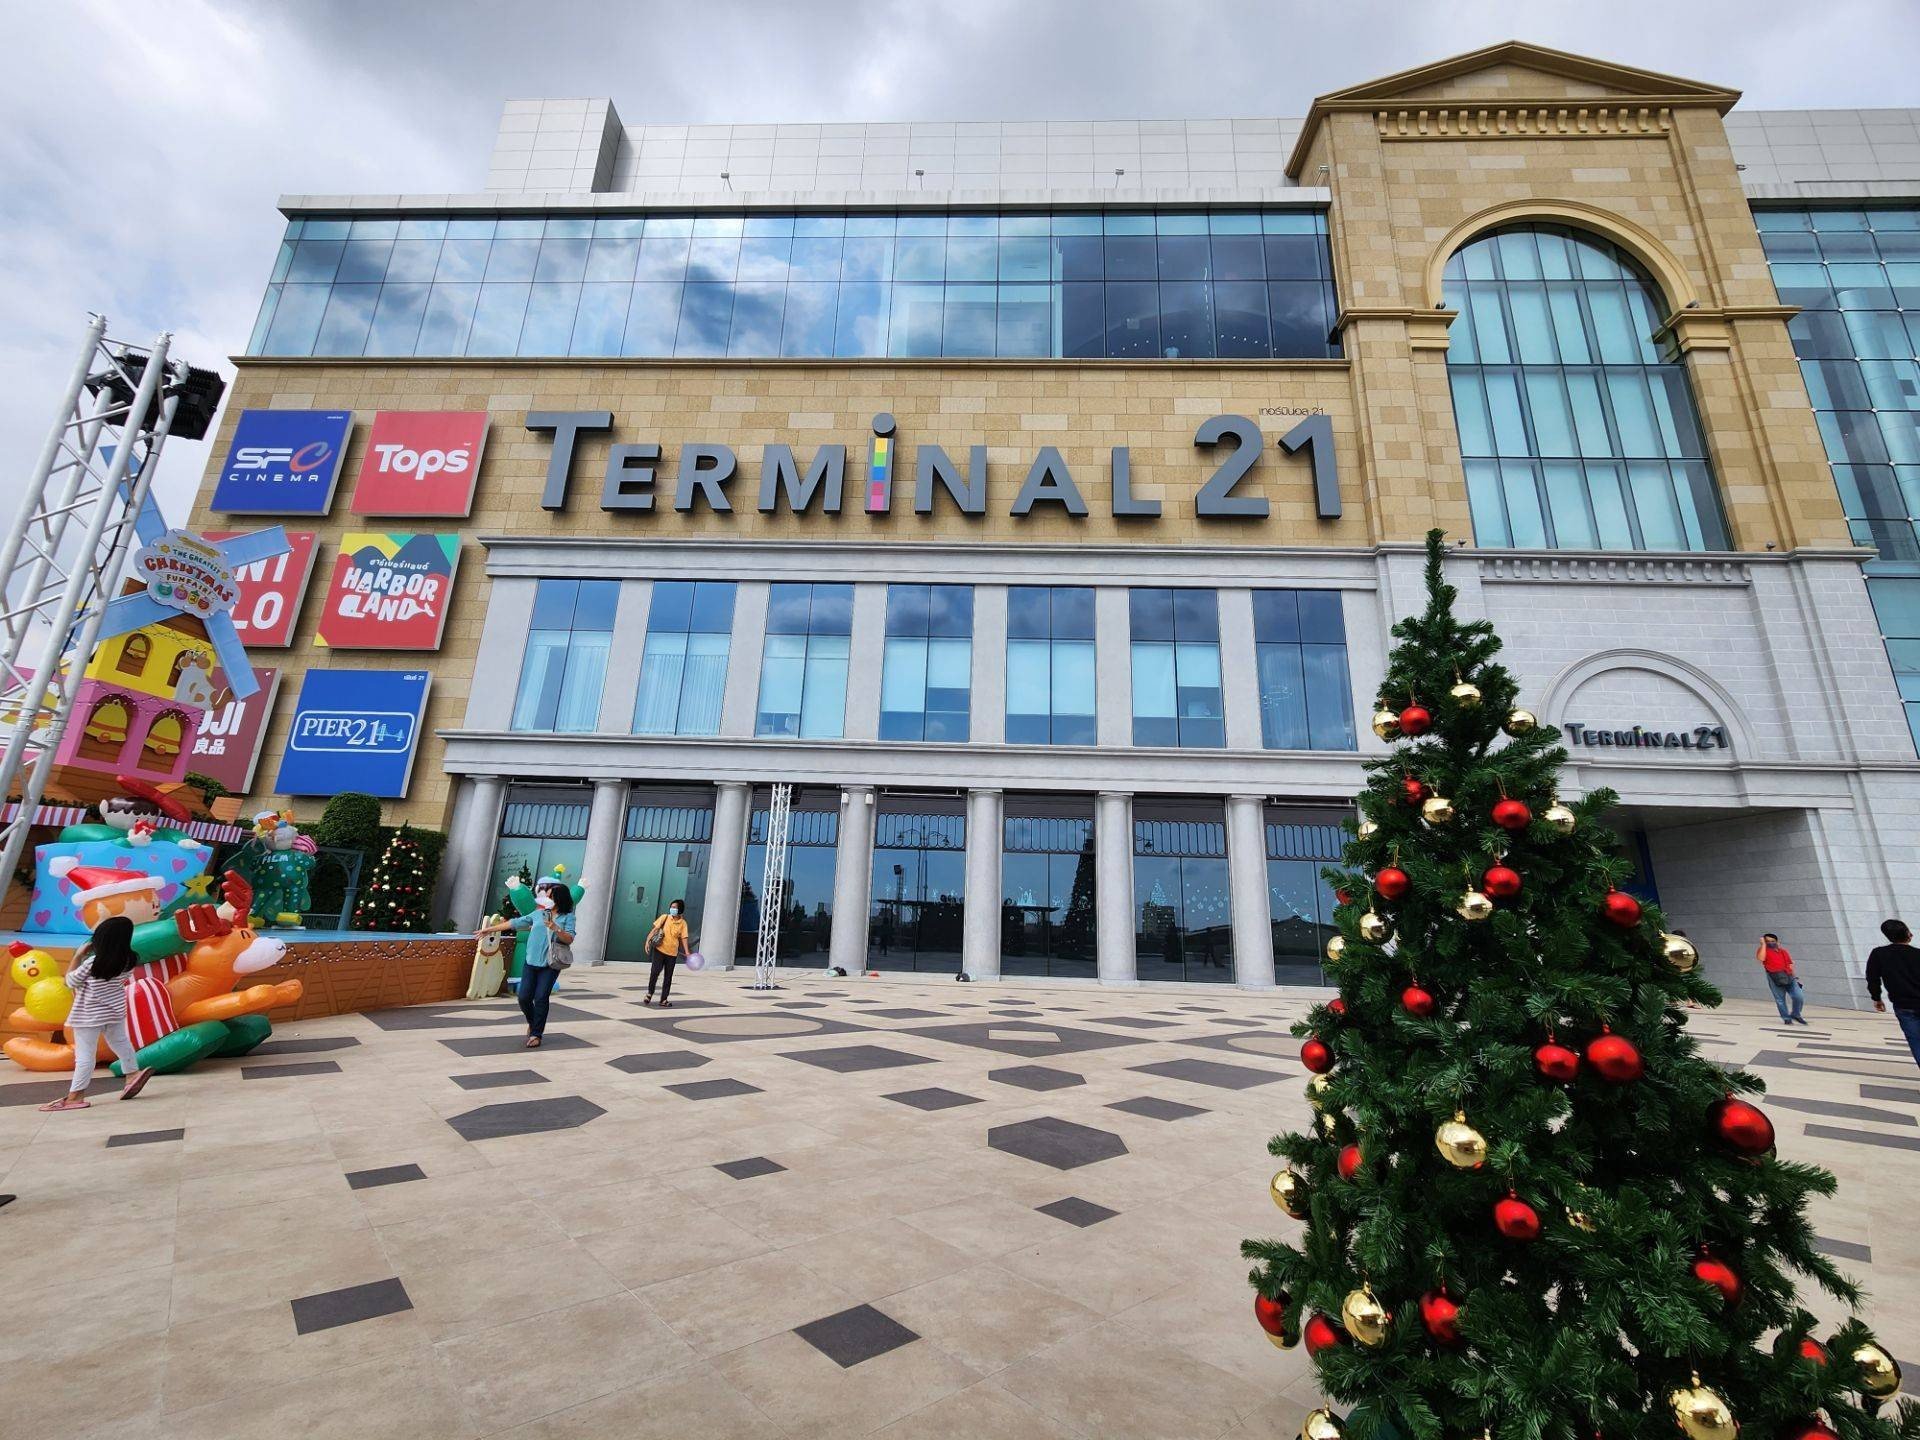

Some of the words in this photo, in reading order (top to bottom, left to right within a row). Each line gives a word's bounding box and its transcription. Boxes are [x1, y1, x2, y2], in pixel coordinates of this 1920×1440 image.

[1312, 407, 1324, 416] 21
[374, 444, 470, 480] Tops
[1194, 414, 1342, 519] 21
[229, 474, 319, 482] CINEMA
[173, 548, 188, 558] THE
[144, 556, 234, 602] CHRISTMAS
[341, 566, 439, 602] HARBOR
[338, 591, 436, 622] LAND
[1694, 726, 1728, 750] 21
